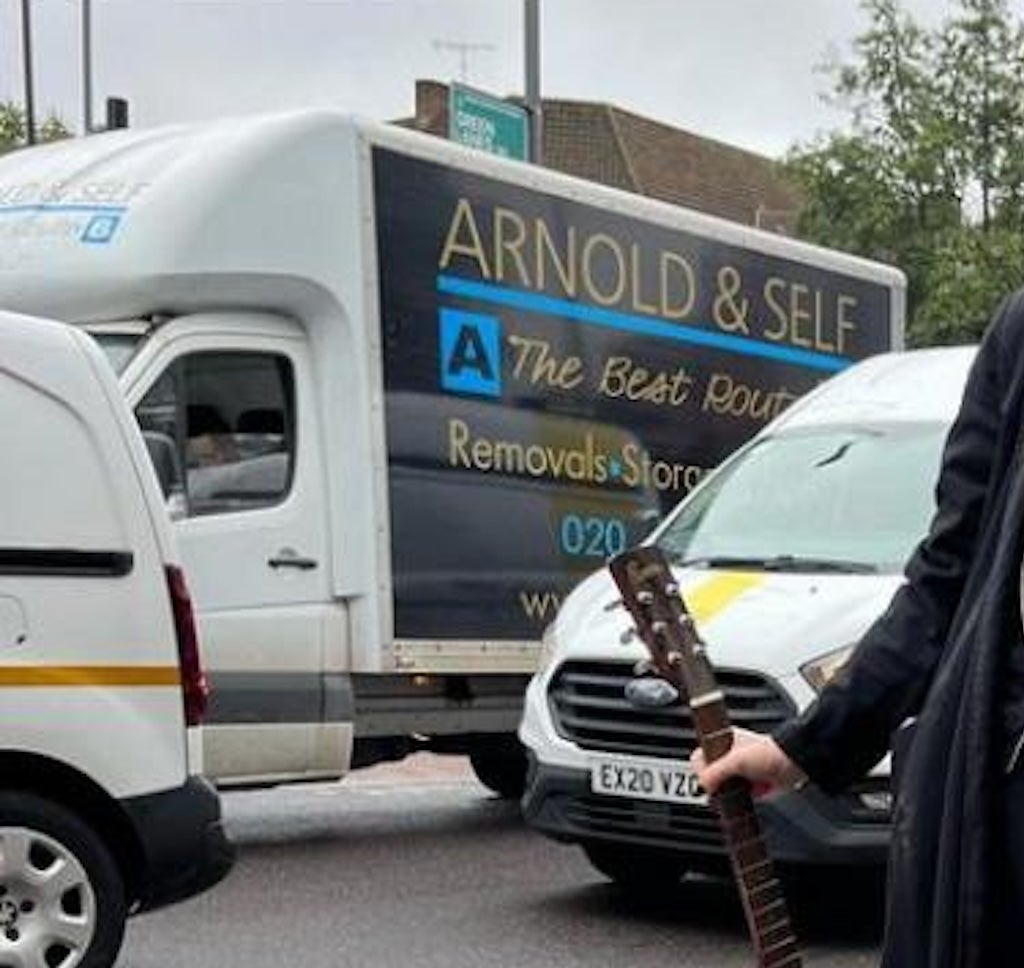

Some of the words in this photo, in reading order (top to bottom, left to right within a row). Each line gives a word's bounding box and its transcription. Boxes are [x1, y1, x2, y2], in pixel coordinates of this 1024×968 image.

[438, 198, 697, 318] ARNOLD
[713, 265, 750, 335] &
[764, 278, 858, 354] SELF
[448, 324, 496, 382] A
[508, 335, 585, 390] The
[600, 356, 694, 406] Best
[449, 419, 608, 483] Removals
[561, 515, 626, 557] 020
[600, 764, 654, 794] EX20
